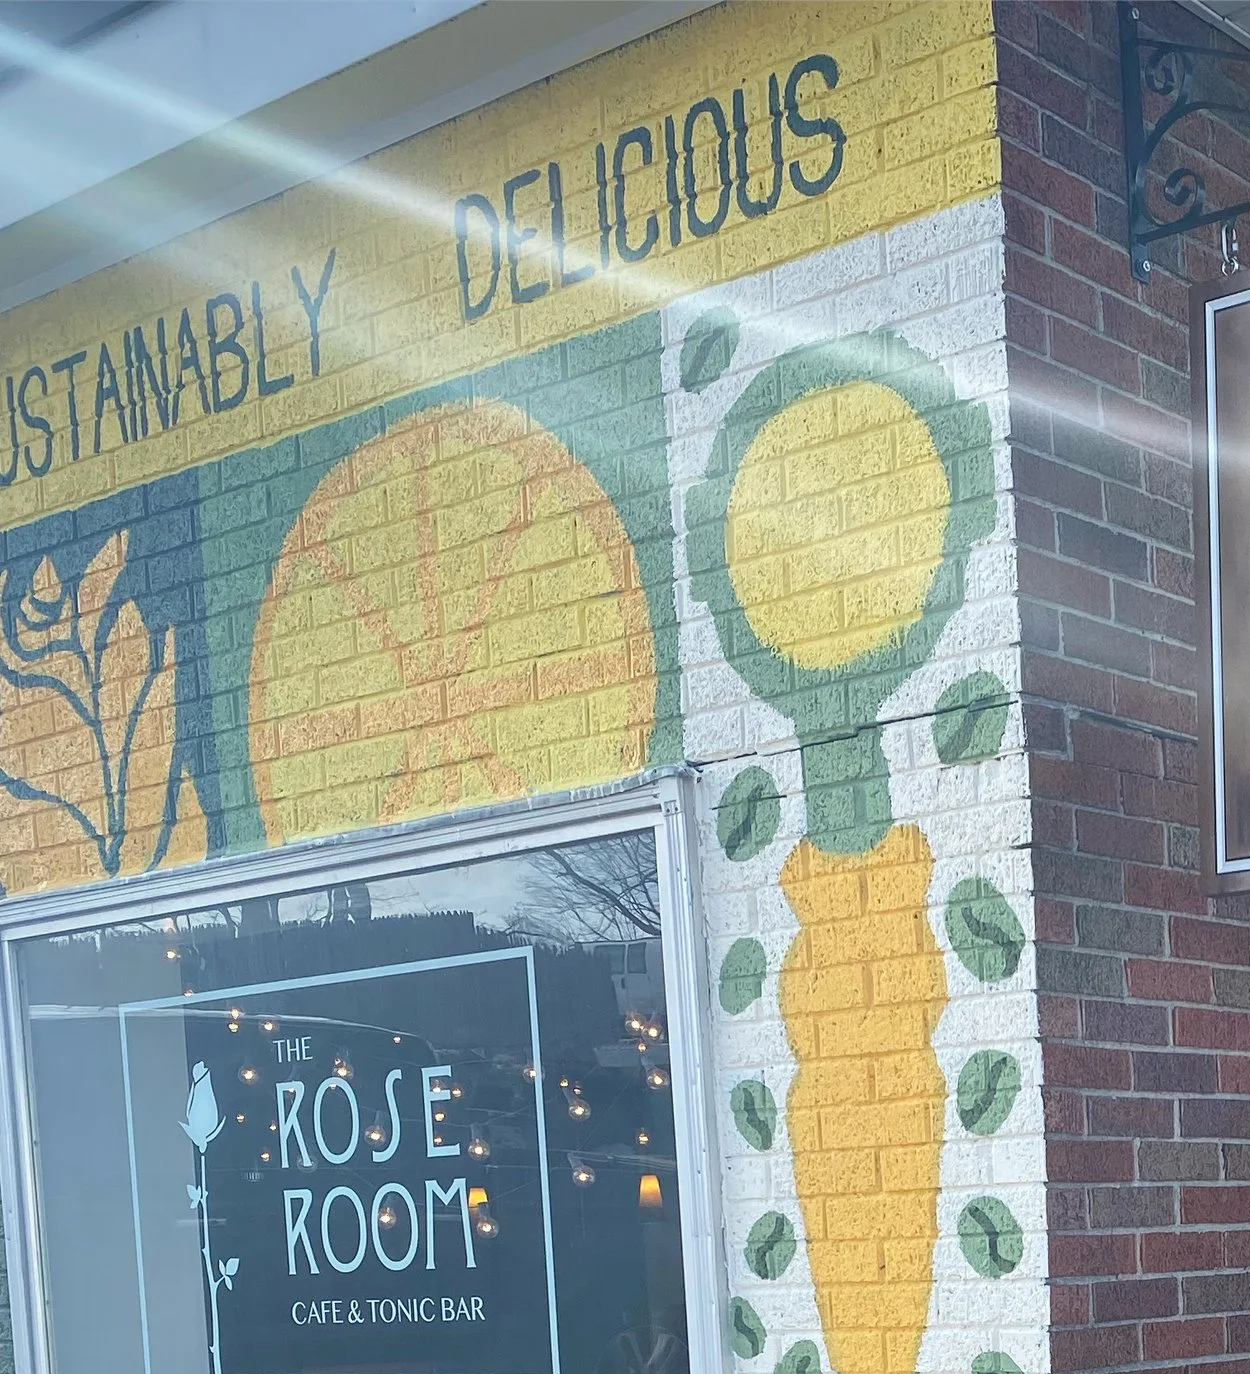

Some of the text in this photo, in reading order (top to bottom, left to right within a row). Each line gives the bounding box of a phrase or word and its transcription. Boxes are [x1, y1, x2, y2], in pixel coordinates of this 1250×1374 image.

[455, 54, 847, 323] DELICIOUS
[273, 1036, 313, 1063] THE
[275, 1065, 461, 1169] ROSE
[283, 1177, 477, 1276] ROOM
[291, 1295, 486, 1326] CAFE & TONIC BAR
